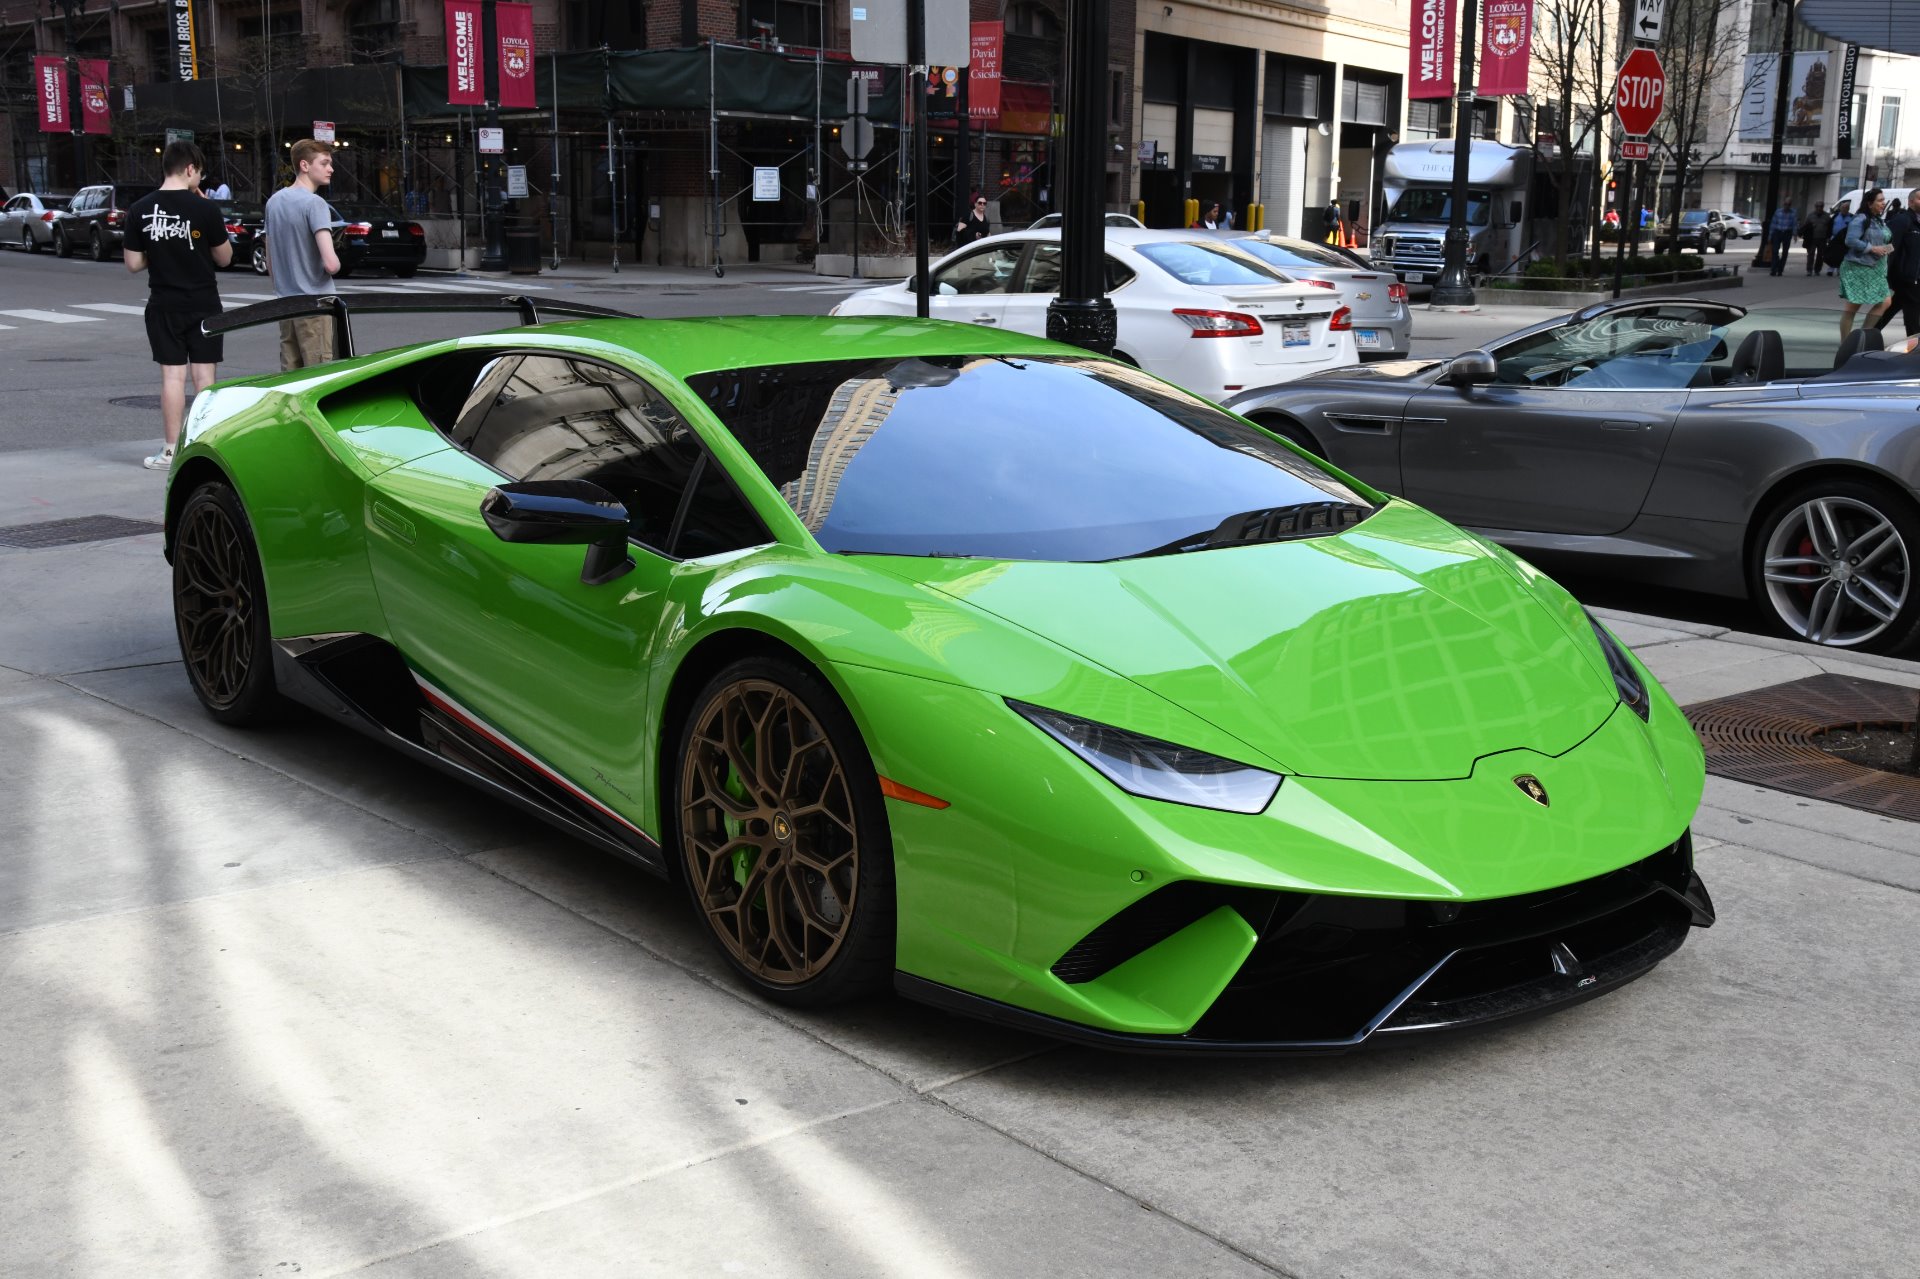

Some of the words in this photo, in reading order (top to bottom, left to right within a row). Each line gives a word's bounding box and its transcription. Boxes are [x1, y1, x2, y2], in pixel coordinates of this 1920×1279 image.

[1489, 3, 1527, 13] LOYOLA
[1639, 0, 1661, 13] WAY
[176, 11, 191, 41] BROS.
[1437, 18, 1445, 51] TOWER
[502, 37, 529, 45] LOYOLA
[455, 11, 469, 91] WELCOME
[972, 48, 996, 58] David
[981, 58, 996, 68] Lee
[1435, 52, 1444, 81] WATER
[468, 68, 476, 92] WATER
[970, 69, 1000, 79] Csicsko
[43, 66, 57, 123] WELCOME
[1619, 75, 1663, 109] STOP
[968, 107, 997, 115] LUMA
[1838, 109, 1849, 139] rack
[1624, 145, 1634, 155] ALL
[1635, 146, 1647, 156] WAY
